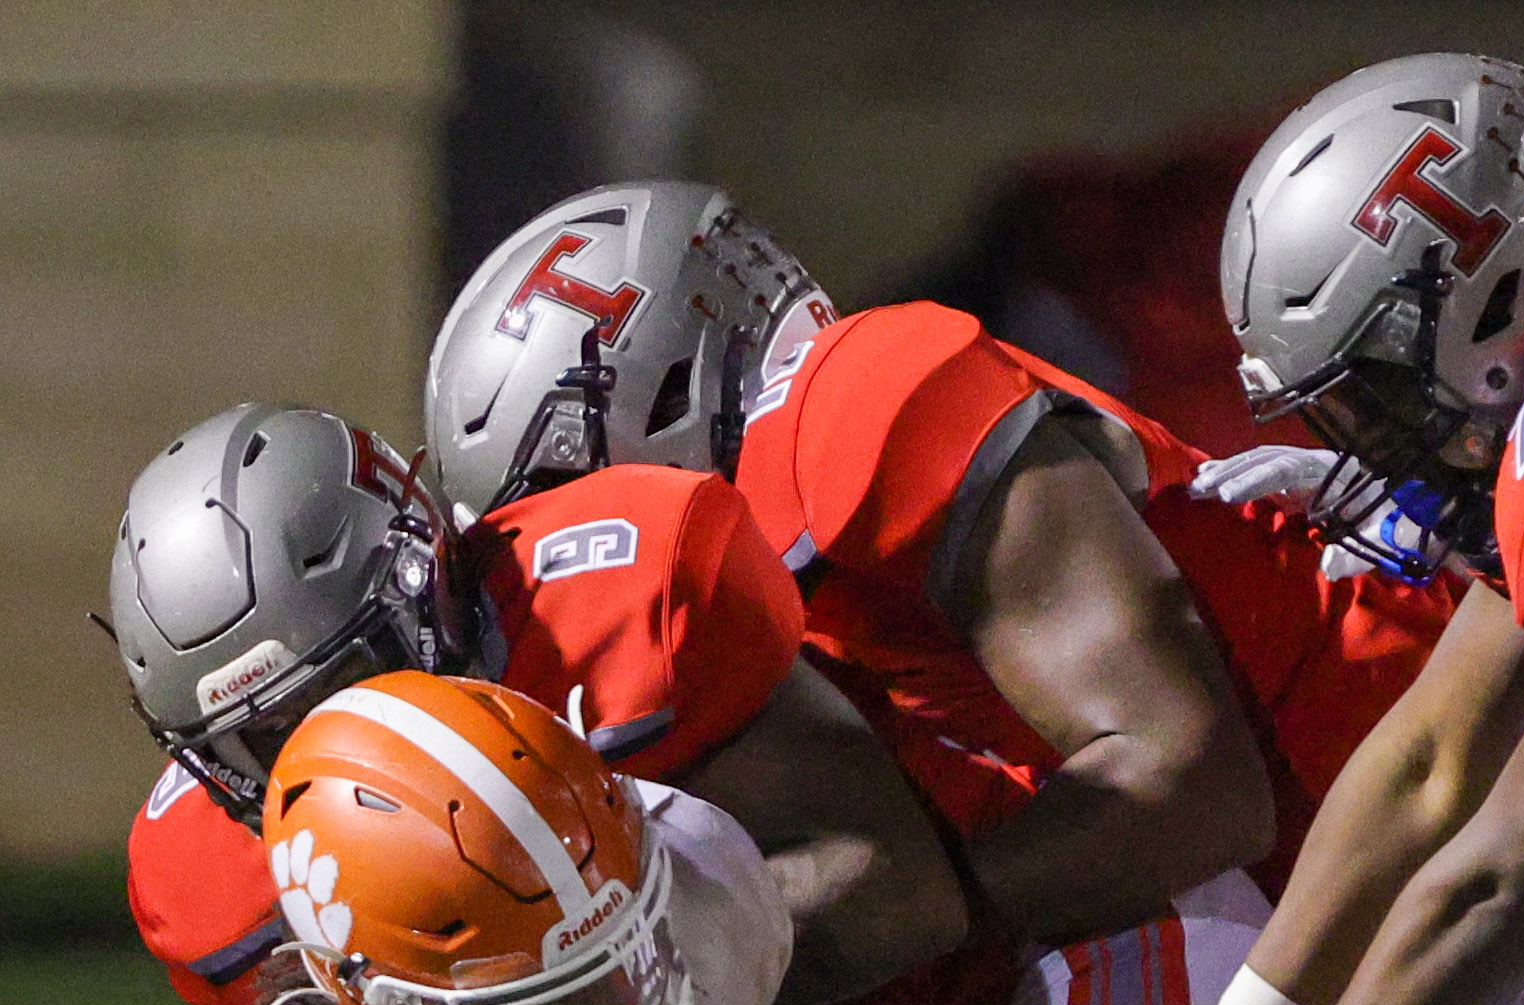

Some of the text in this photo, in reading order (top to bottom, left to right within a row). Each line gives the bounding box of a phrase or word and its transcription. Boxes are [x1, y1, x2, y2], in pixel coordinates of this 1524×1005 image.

[1351, 121, 1513, 278] T
[495, 231, 648, 351] T
[559, 888, 624, 950] Riddell
